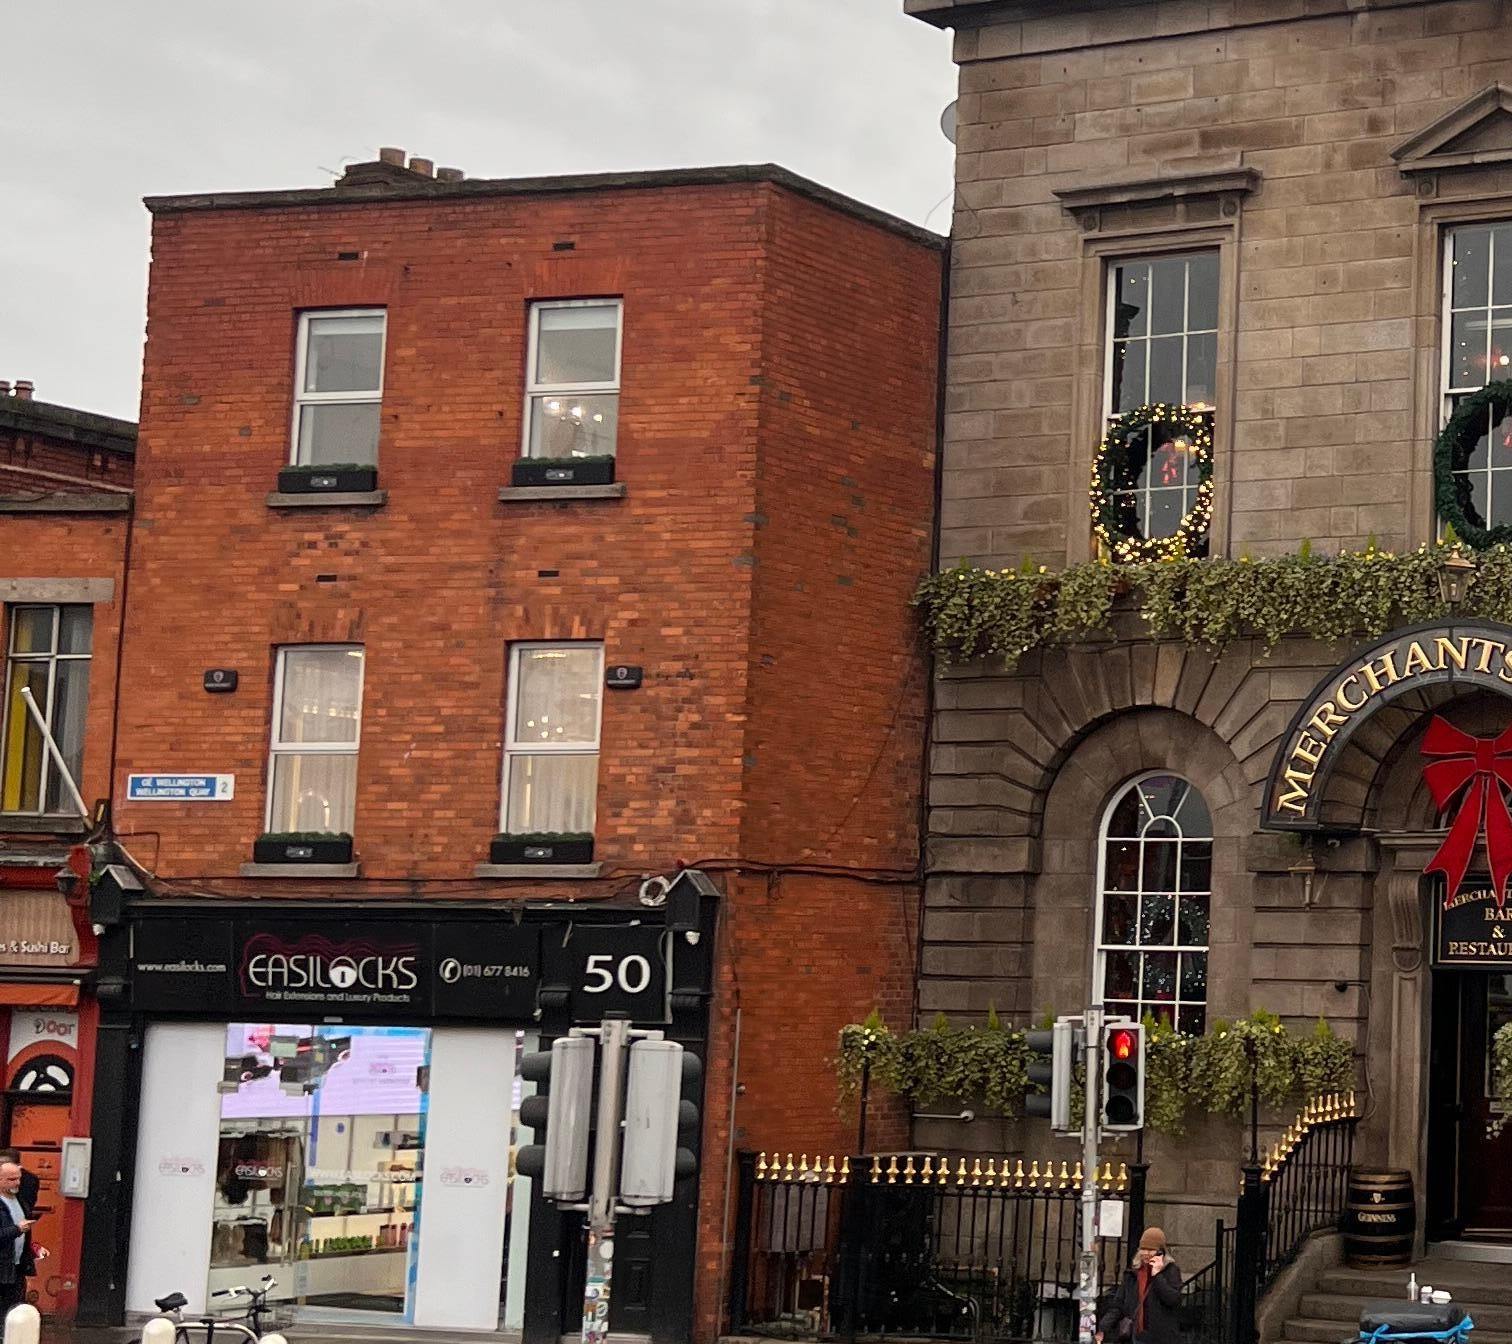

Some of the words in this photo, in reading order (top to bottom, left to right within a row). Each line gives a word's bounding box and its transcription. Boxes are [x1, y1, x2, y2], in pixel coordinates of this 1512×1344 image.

[221, 782, 228, 793] 2
[1491, 925, 1506, 938] &
[21, 940, 48, 953] Sushi
[50, 941, 70, 954] Bar
[249, 954, 418, 990] EASILOCKS
[583, 955, 651, 993] 50
